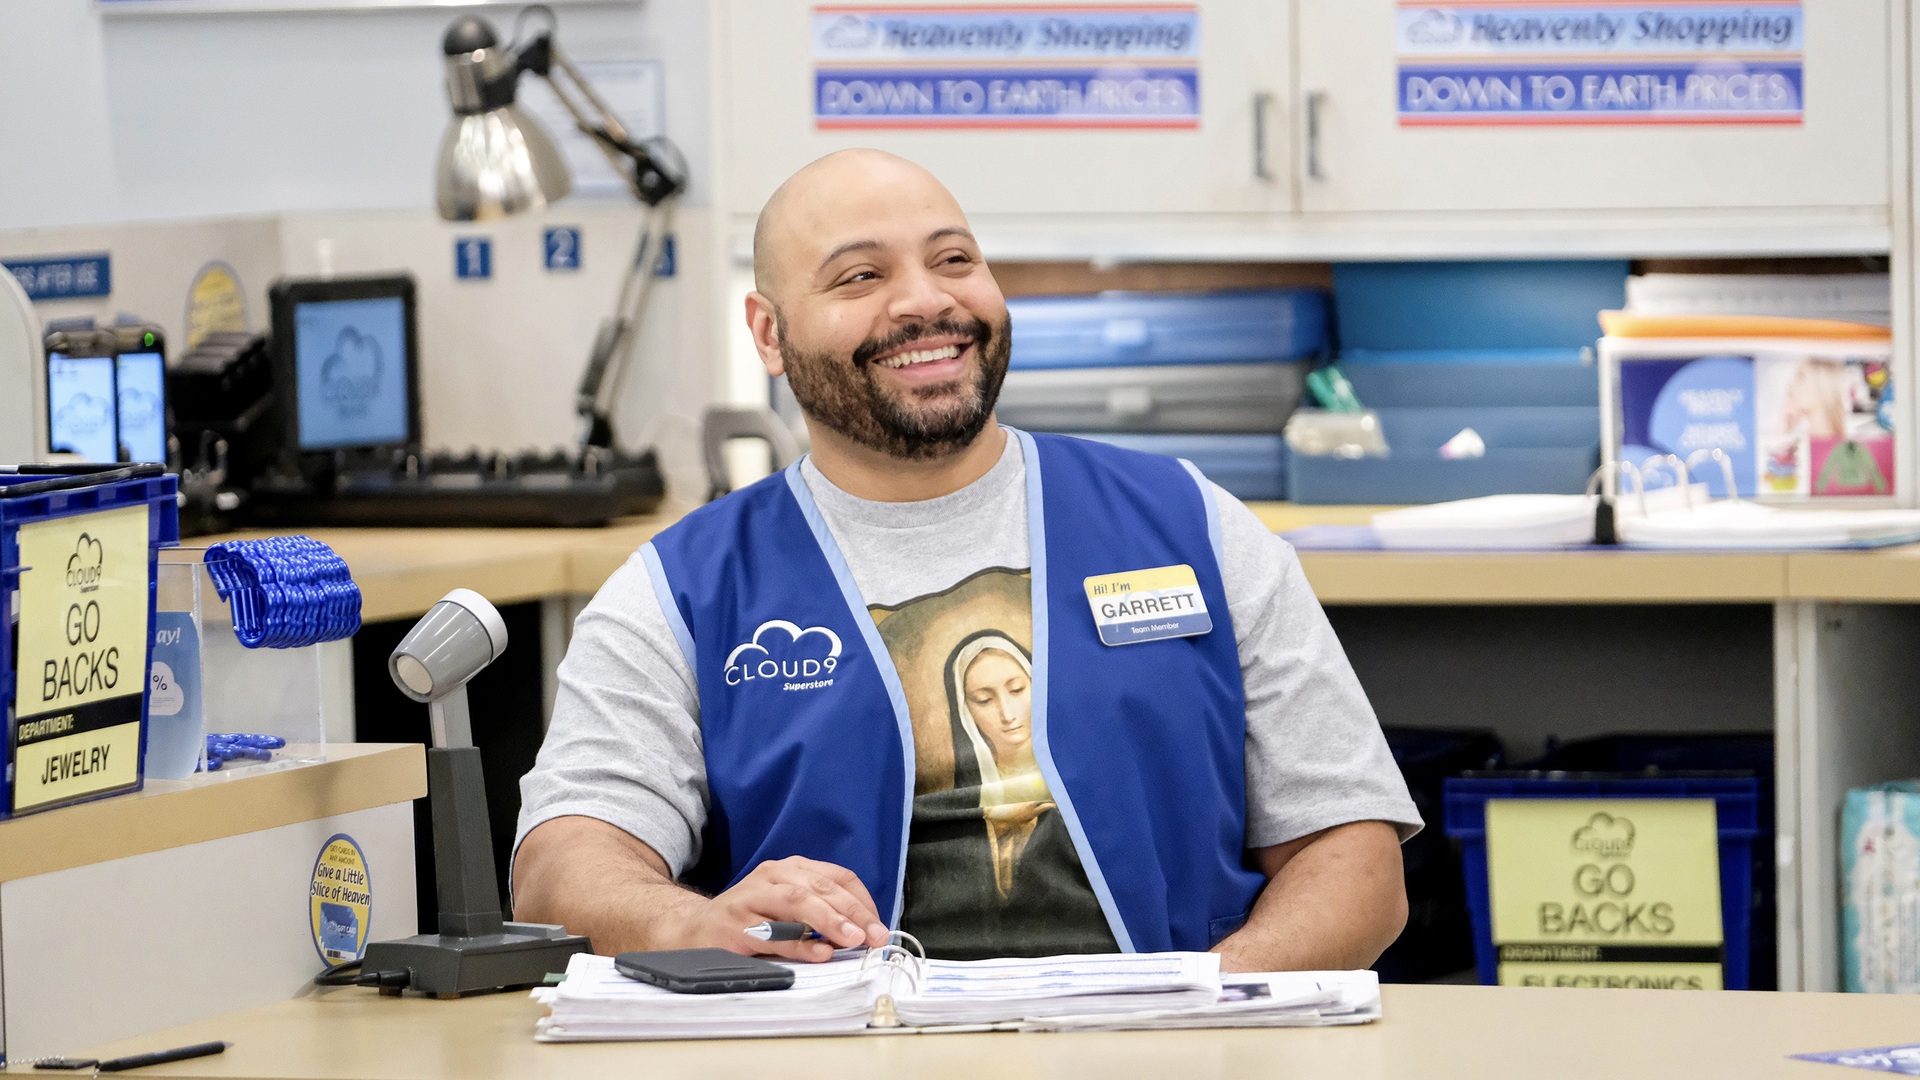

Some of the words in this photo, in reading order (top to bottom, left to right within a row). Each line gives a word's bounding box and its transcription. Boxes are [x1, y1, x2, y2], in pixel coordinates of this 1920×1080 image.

[882, 18, 1026, 54] Heavenly
[1038, 16, 1194, 52] Shopping
[1471, 11, 1625, 48] Heavenly
[1634, 9, 1795, 46] Shopping
[820, 79, 935, 115] DOWN
[940, 79, 985, 115] TO
[988, 79, 1083, 115] EARTH
[1084, 79, 1193, 115] PRICES
[1406, 74, 1523, 111] DOWN
[1529, 74, 1576, 111] TO
[1581, 74, 1677, 111] EARTH
[1684, 73, 1789, 111] PRICES
[466, 240, 483, 277] 1
[551, 229, 575, 267] 2
[66, 564, 101, 587] CLOUD9
[1093, 583, 1108, 595] Hi!
[1112, 582, 1131, 593] I'm
[66, 600, 101, 646] GO
[1100, 592, 1195, 619] GARRETT
[1131, 625, 1151, 634] Team
[1151, 622, 1180, 632] Member
[42, 646, 120, 702] BACKS
[725, 656, 838, 686] CLOUD9
[783, 678, 834, 691] Superstore
[18, 713, 75, 741] DEPARTMENT:
[41, 743, 111, 785] JEWELRY
[317, 862, 335, 879] Give
[335, 868, 342, 880] a
[343, 867, 365, 885] Little
[1572, 863, 1636, 898] GO
[311, 880, 331, 898] Slice
[331, 885, 342, 902] of
[342, 886, 370, 906] Heaven
[1538, 900, 1676, 937] BACKS
